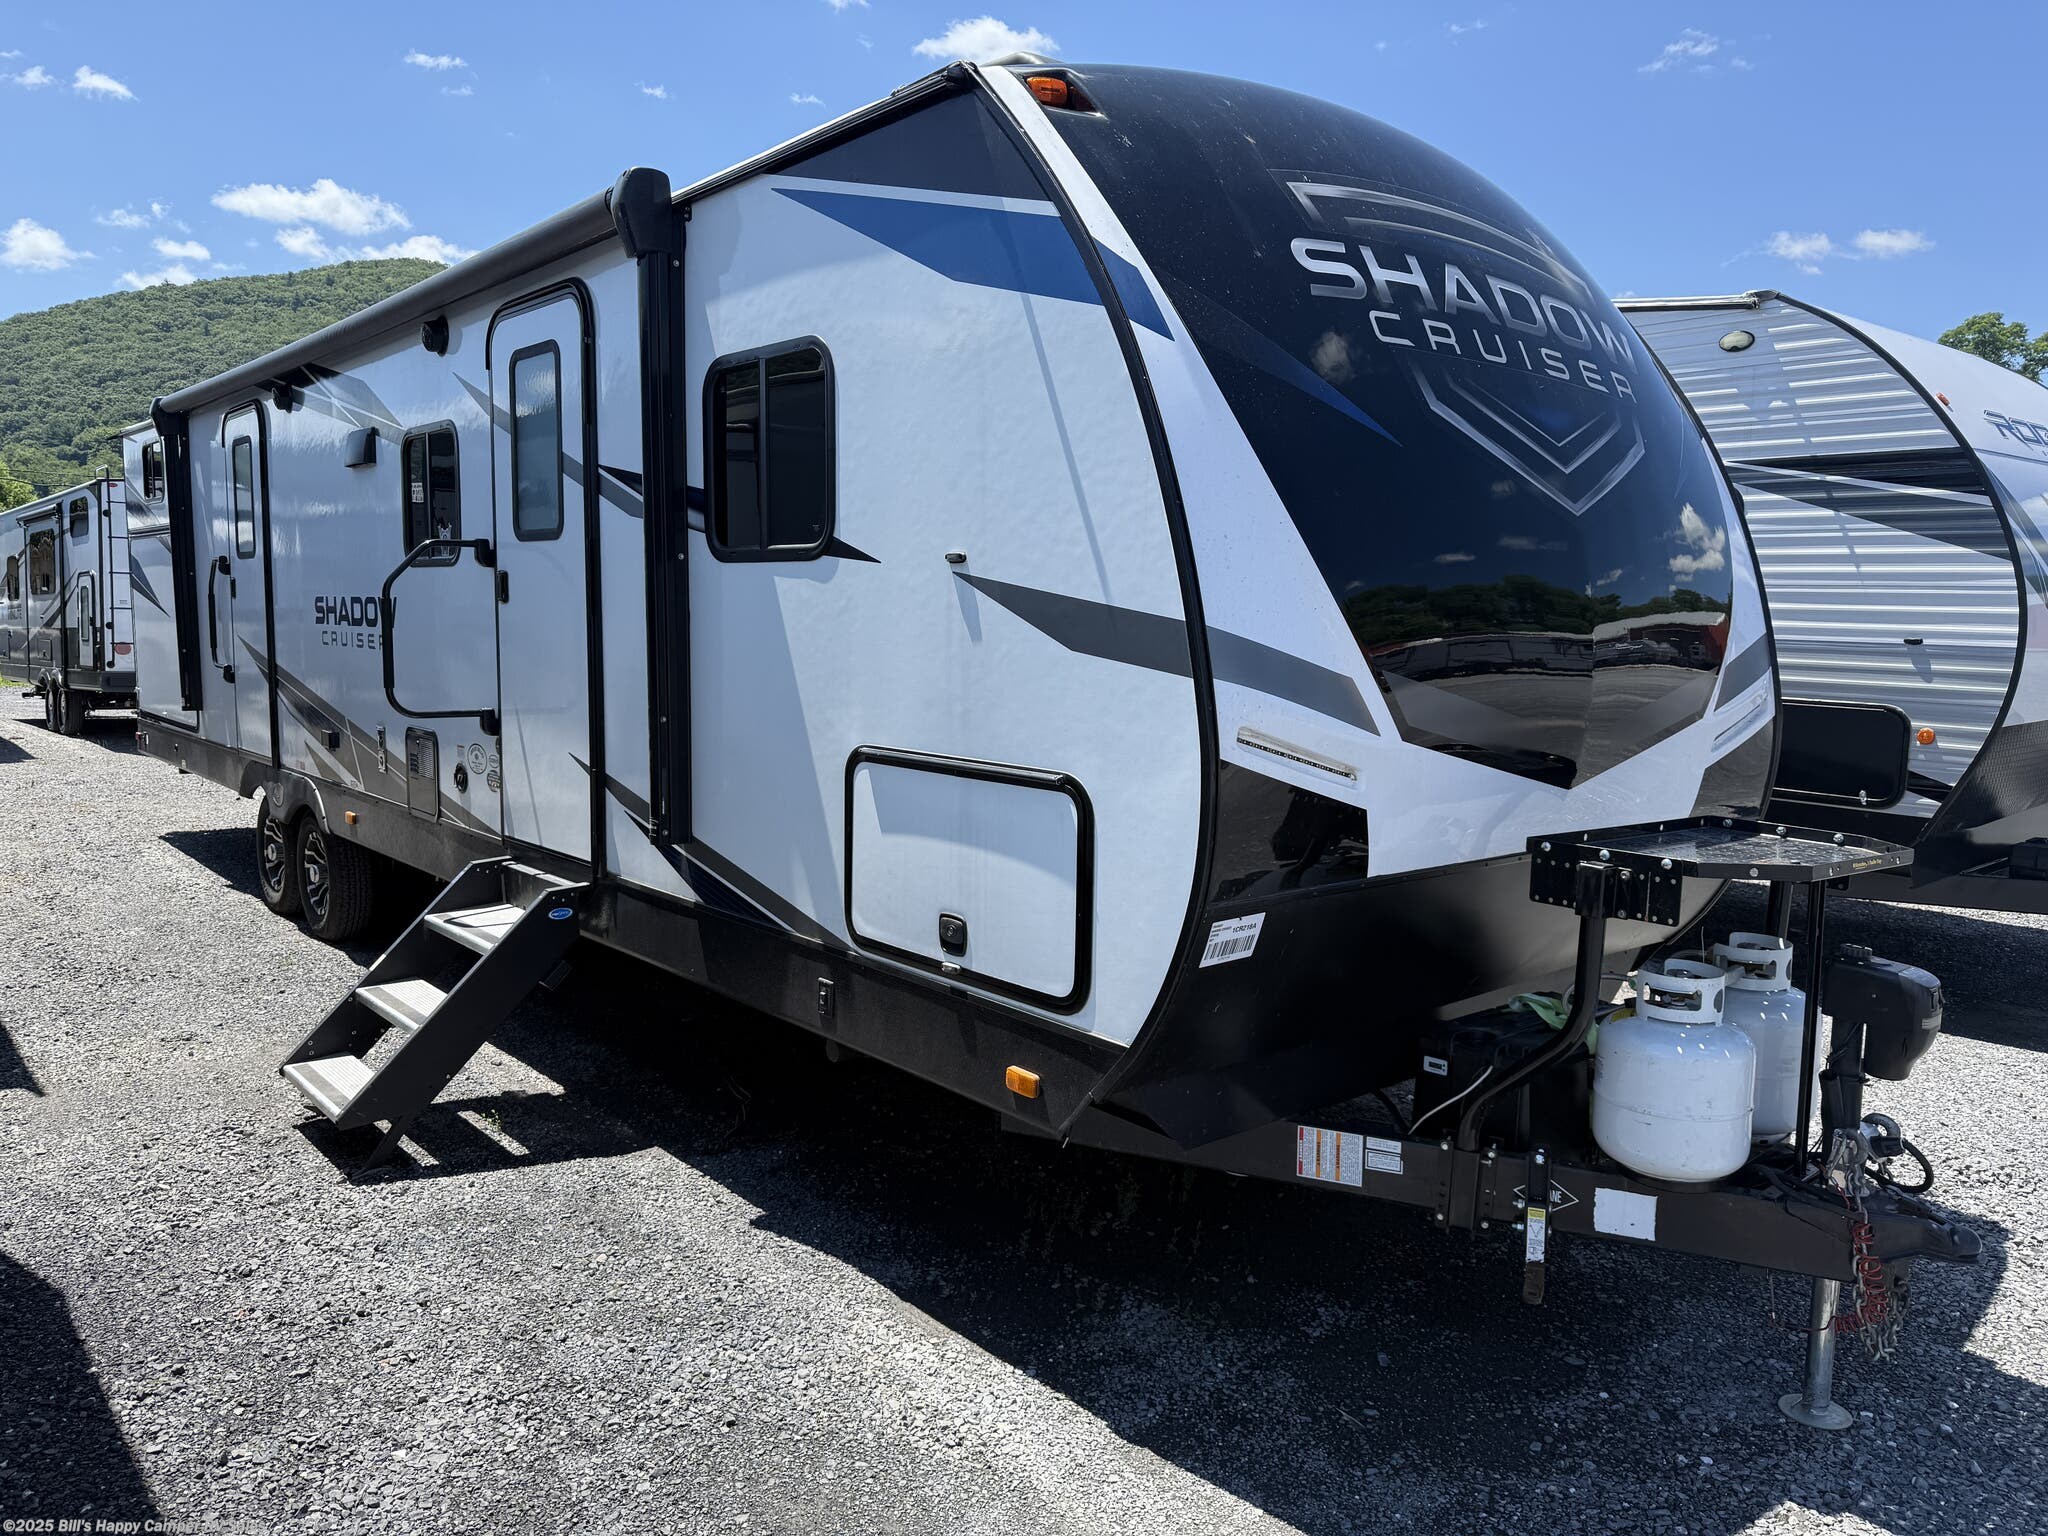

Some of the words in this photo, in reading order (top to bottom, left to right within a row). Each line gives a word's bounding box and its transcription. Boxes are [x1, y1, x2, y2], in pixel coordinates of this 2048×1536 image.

[1290, 237, 1638, 374] SHADOW
[1369, 309, 1638, 404] CRUISER
[321, 630, 384, 651] CRUISE
